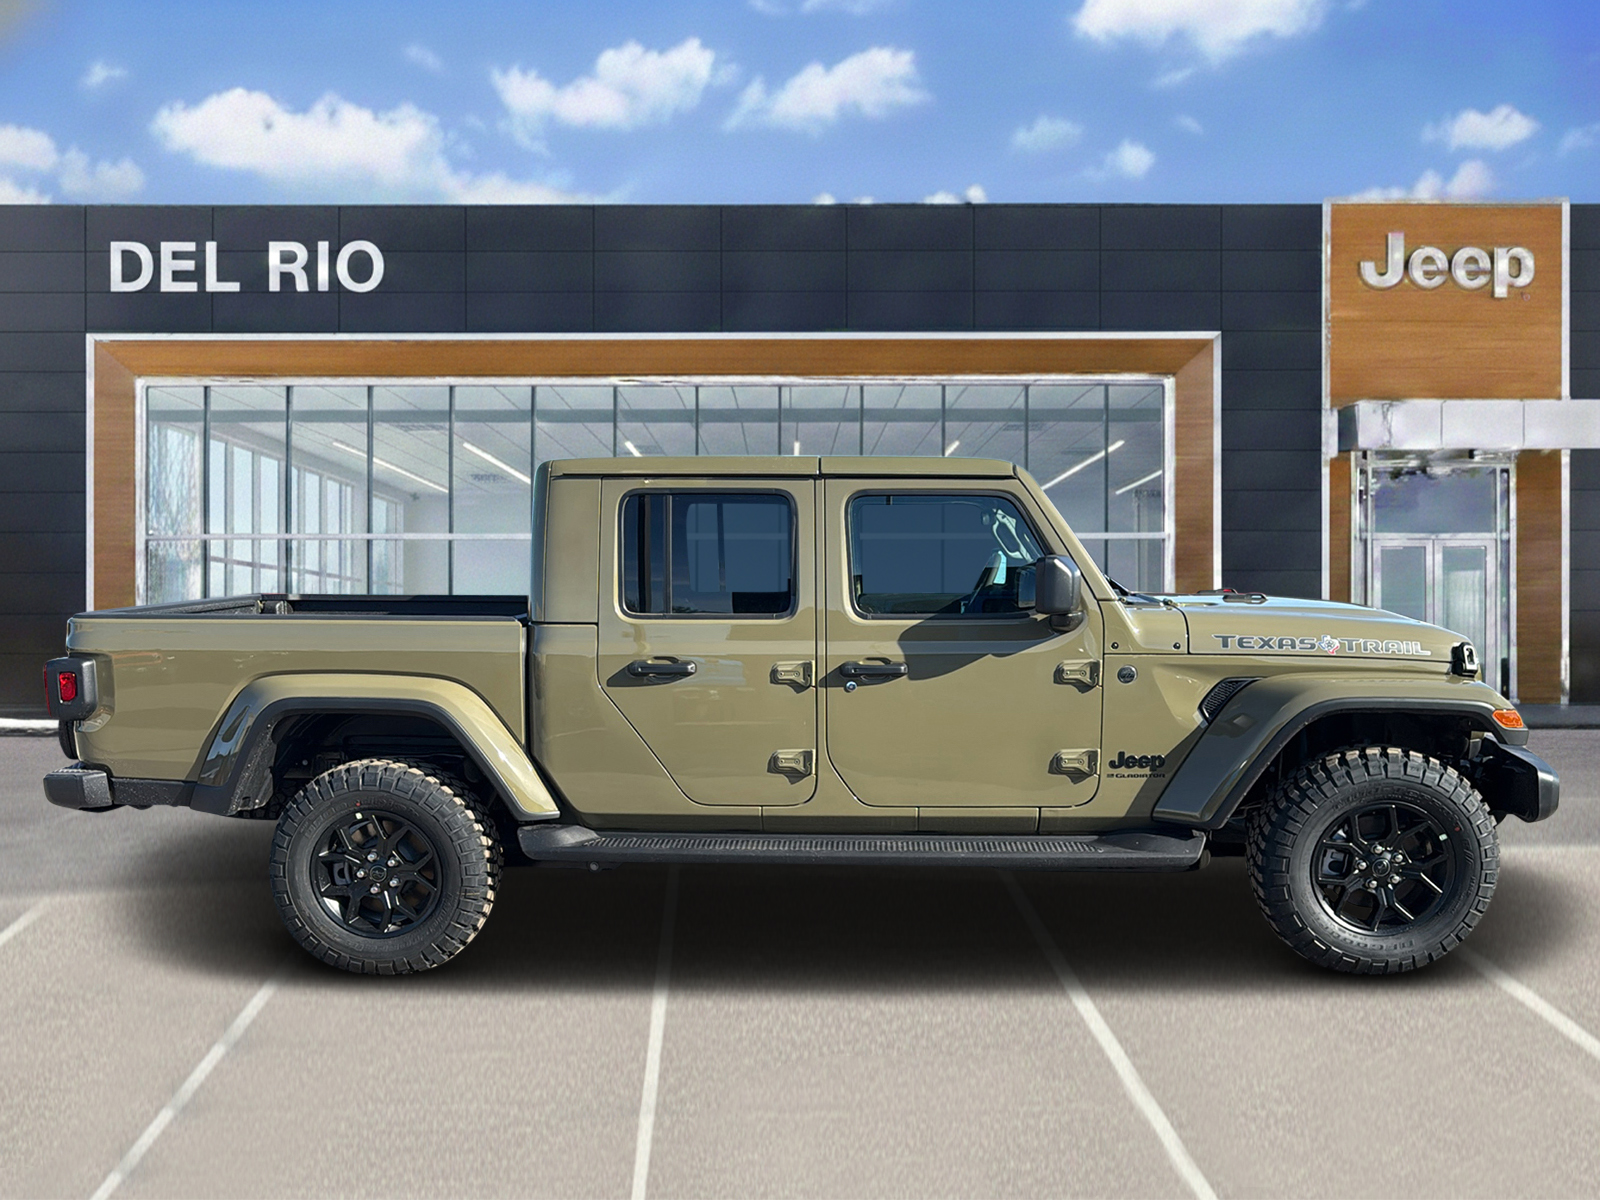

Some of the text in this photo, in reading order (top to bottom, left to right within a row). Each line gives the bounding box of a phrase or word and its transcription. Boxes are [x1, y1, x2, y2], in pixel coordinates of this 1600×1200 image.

[109, 240, 385, 293] DEL RIO
[1360, 231, 1535, 298] Jeep
[1212, 634, 1431, 656] TEXAS TRAIL
[1108, 750, 1166, 772] Jeep
